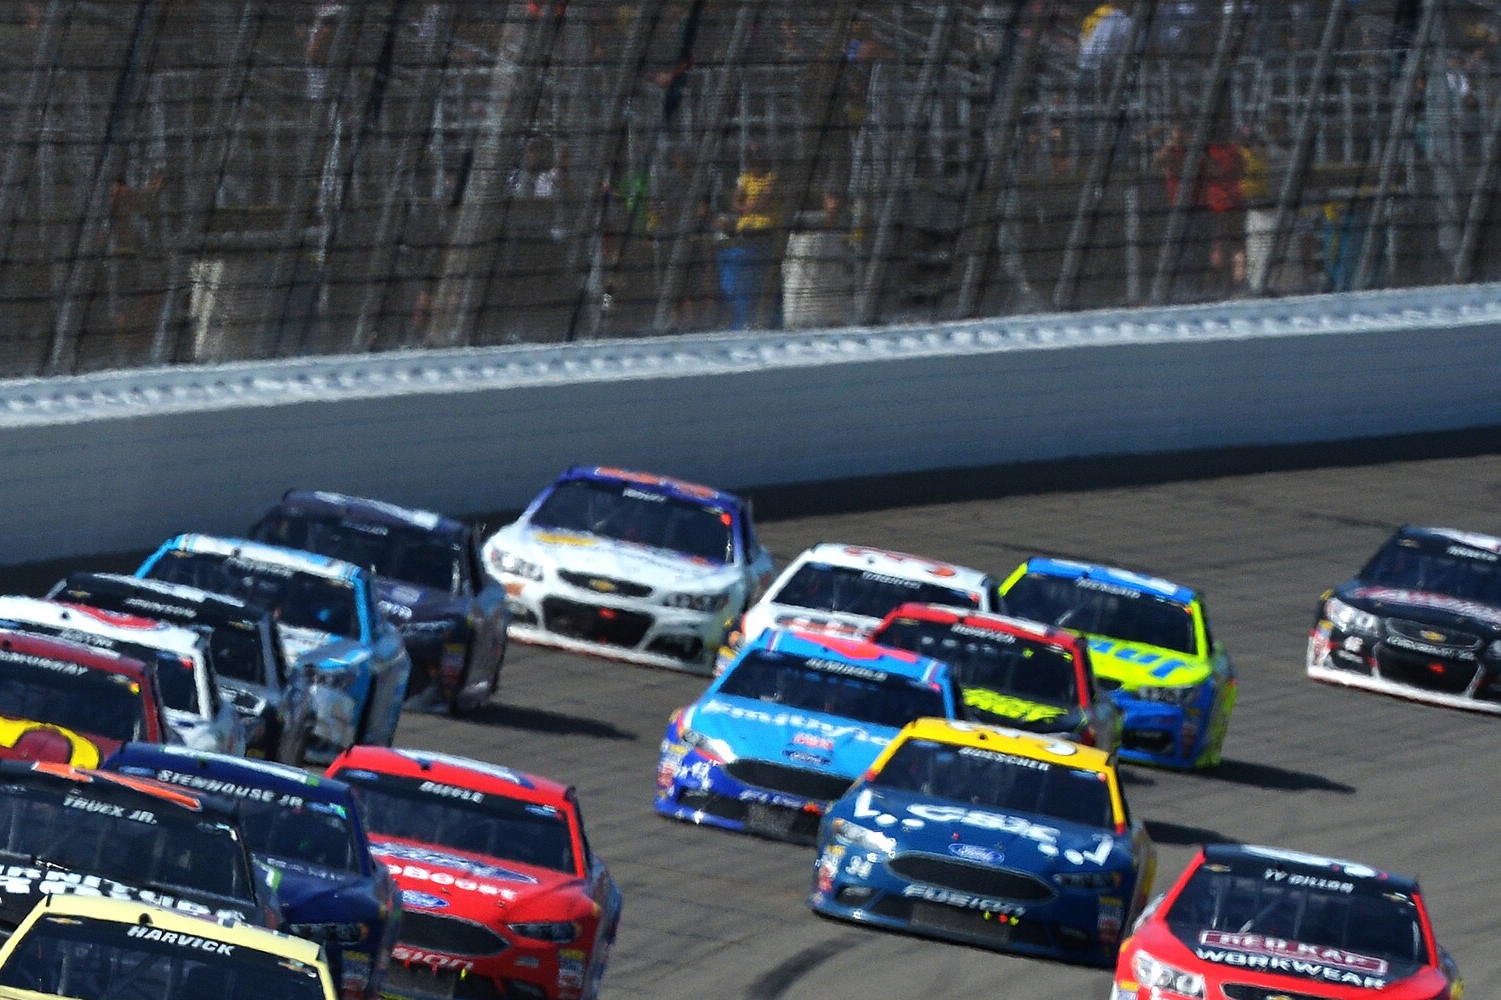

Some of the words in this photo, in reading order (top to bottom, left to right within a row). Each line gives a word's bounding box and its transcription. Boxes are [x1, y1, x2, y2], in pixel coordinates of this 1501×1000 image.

[157, 769, 276, 802] STENHOUSE
[278, 794, 303, 808] JR
[63, 795, 126, 818] TRUEX
[387, 865, 519, 902] oBoost
[1288, 872, 1355, 893] DILLON
[127, 925, 236, 956] HARVICK
[1220, 934, 1287, 949] RED
[1298, 942, 1368, 966] KAP
[1196, 947, 1388, 991] WORKWEAR
